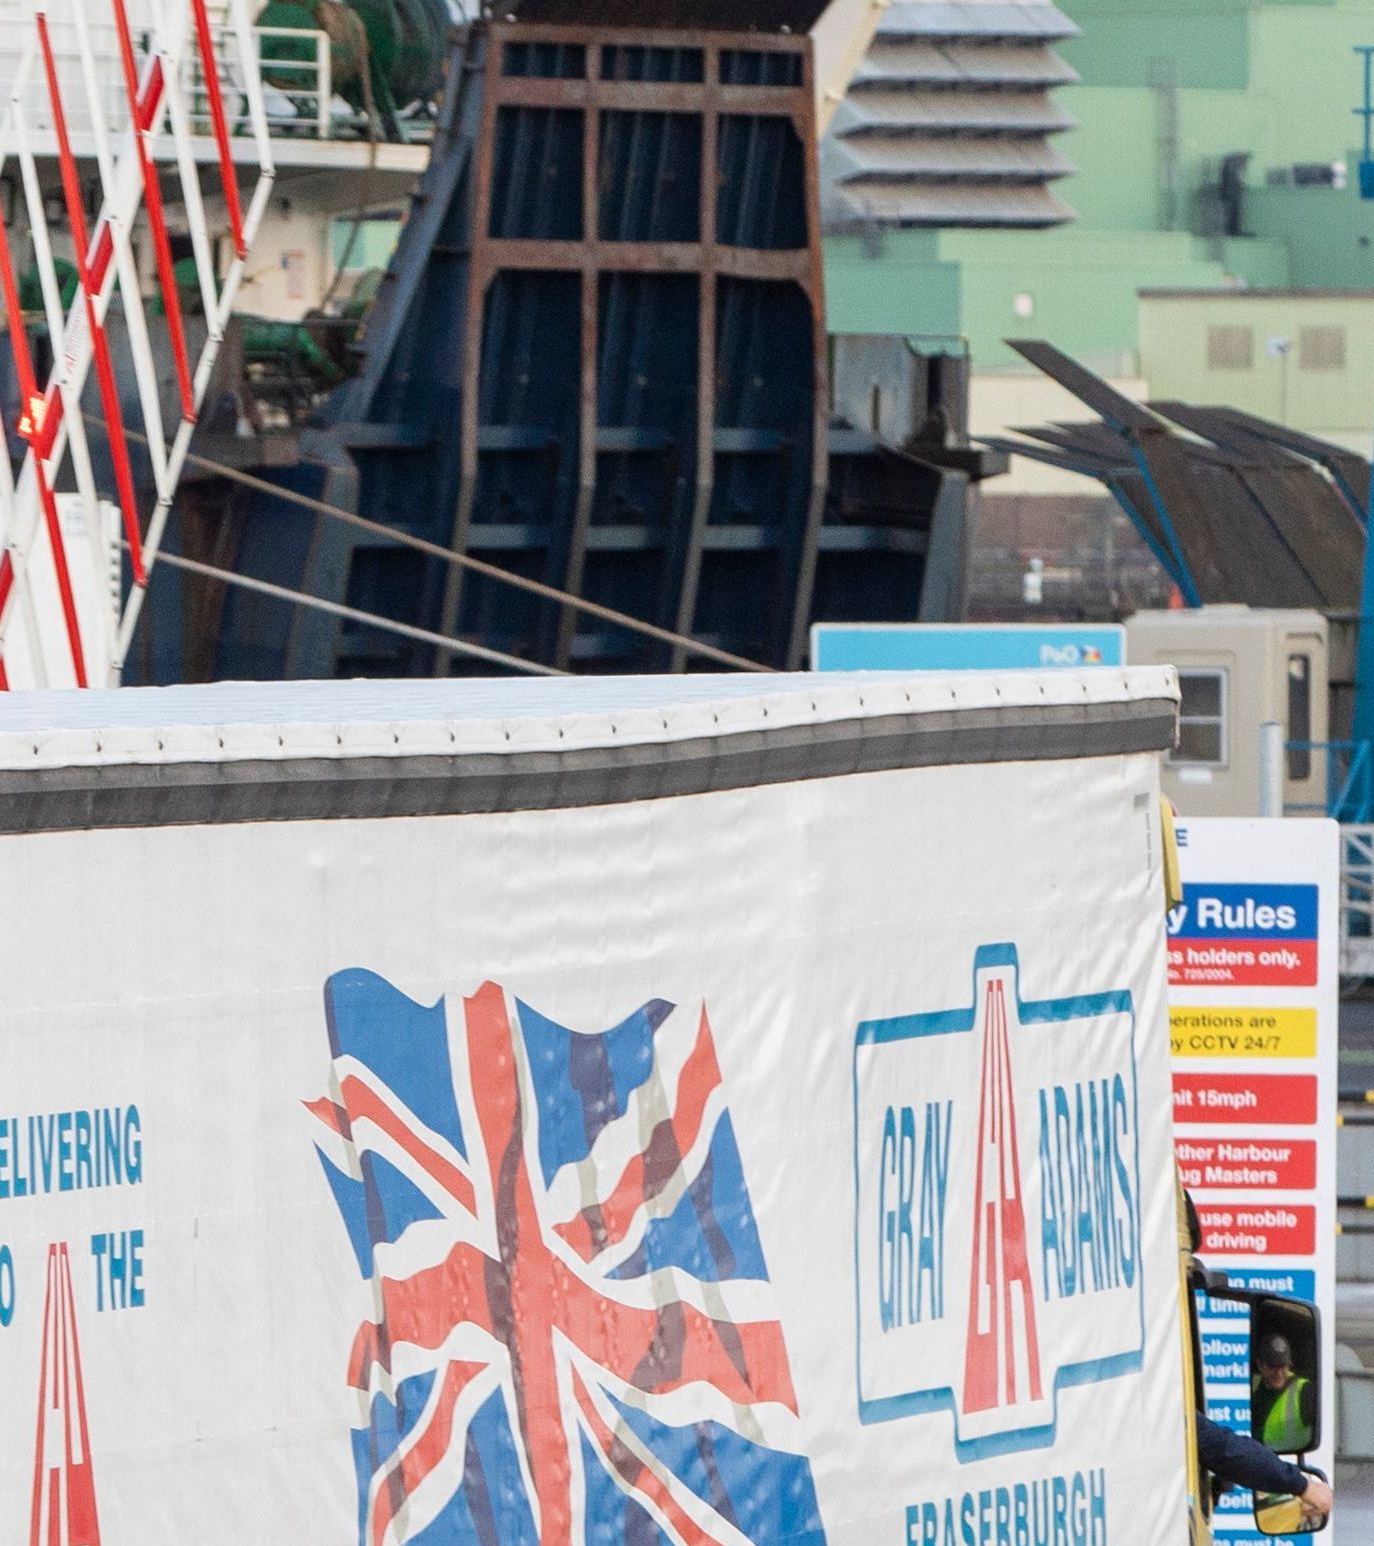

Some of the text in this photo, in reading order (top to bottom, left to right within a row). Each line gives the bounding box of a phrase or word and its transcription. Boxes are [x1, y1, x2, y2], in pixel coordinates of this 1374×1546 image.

[1197, 897, 1297, 930] Rules
[1187, 948, 1255, 965] holders
[1259, 948, 1301, 969] only.
[1169, 1014, 1277, 1028] erations are
[1189, 1035, 1239, 1050] CCTV
[1244, 1036, 1281, 1050] 24/7
[1197, 1089, 1258, 1110] 15mph
[1176, 1144, 1292, 1162] ther Harbour
[1205, 1166, 1278, 1184] Masters
[878, 1100, 954, 1334] GRAY
[1038, 1072, 1136, 1303] ADAMS
[1200, 1211, 1297, 1228] use mobile
[1206, 1232, 1267, 1252] driving
[91, 1228, 146, 1313] THE
[1249, 1276, 1295, 1291] must
[1209, 1296, 1251, 1313] time
[1201, 1340, 1248, 1356] ollow
